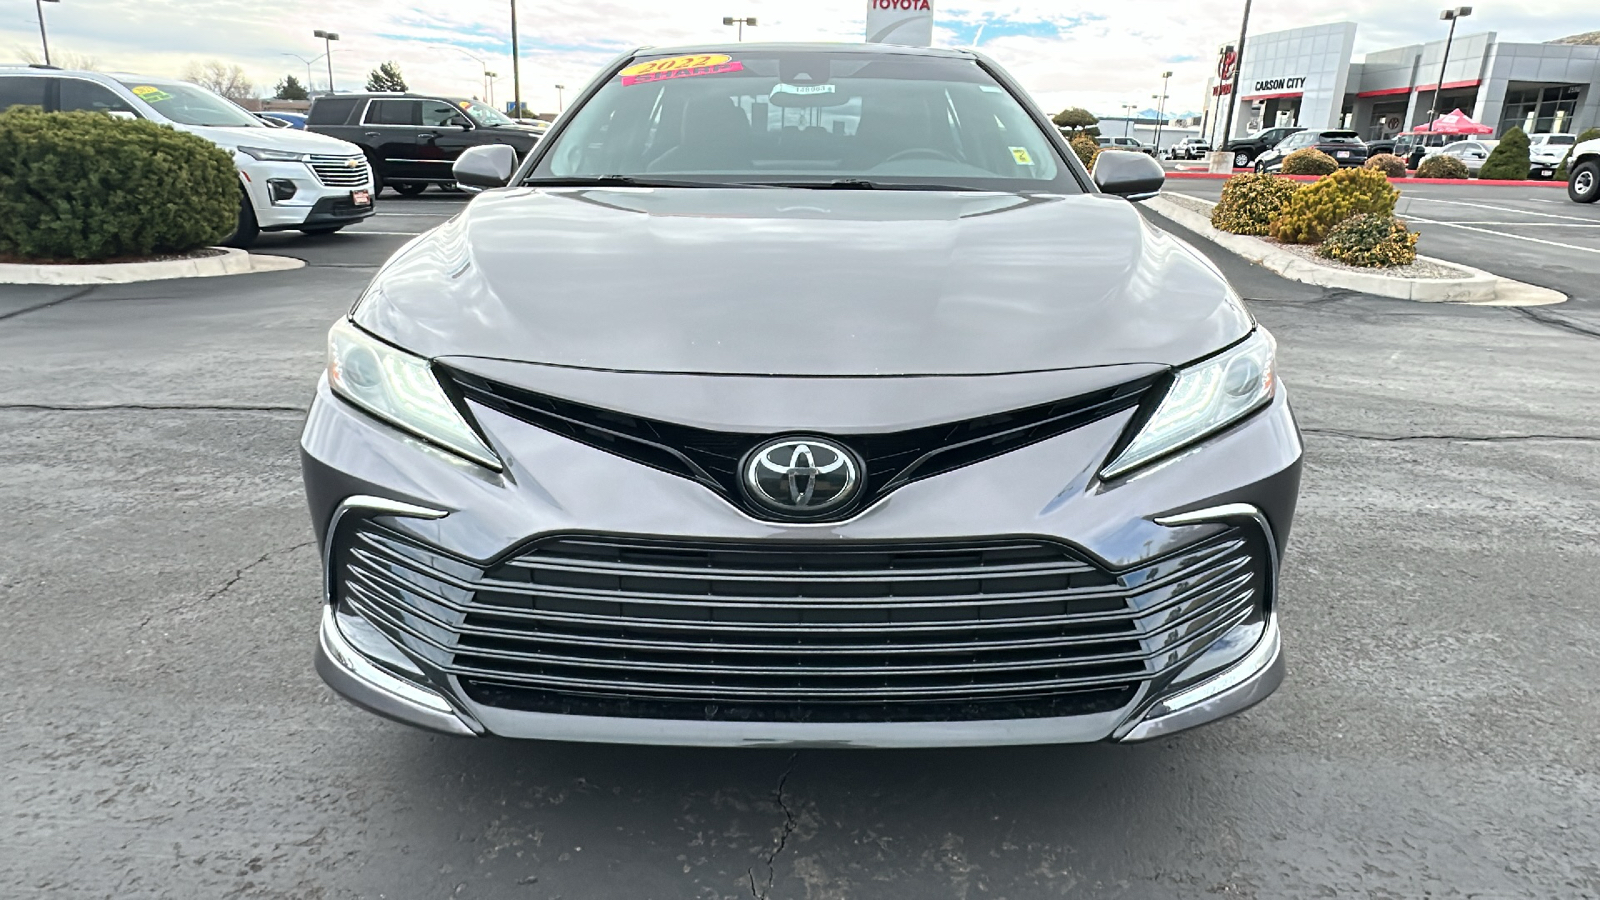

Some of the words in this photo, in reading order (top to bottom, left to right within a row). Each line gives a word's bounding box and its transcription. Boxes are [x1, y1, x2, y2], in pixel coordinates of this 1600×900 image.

[871, 0, 931, 10] TOYOTA
[634, 63, 732, 83] SHARP
[638, 56, 712, 74] 2022
[1254, 78, 1285, 91] CARSON
[1287, 76, 1306, 89] CITY
